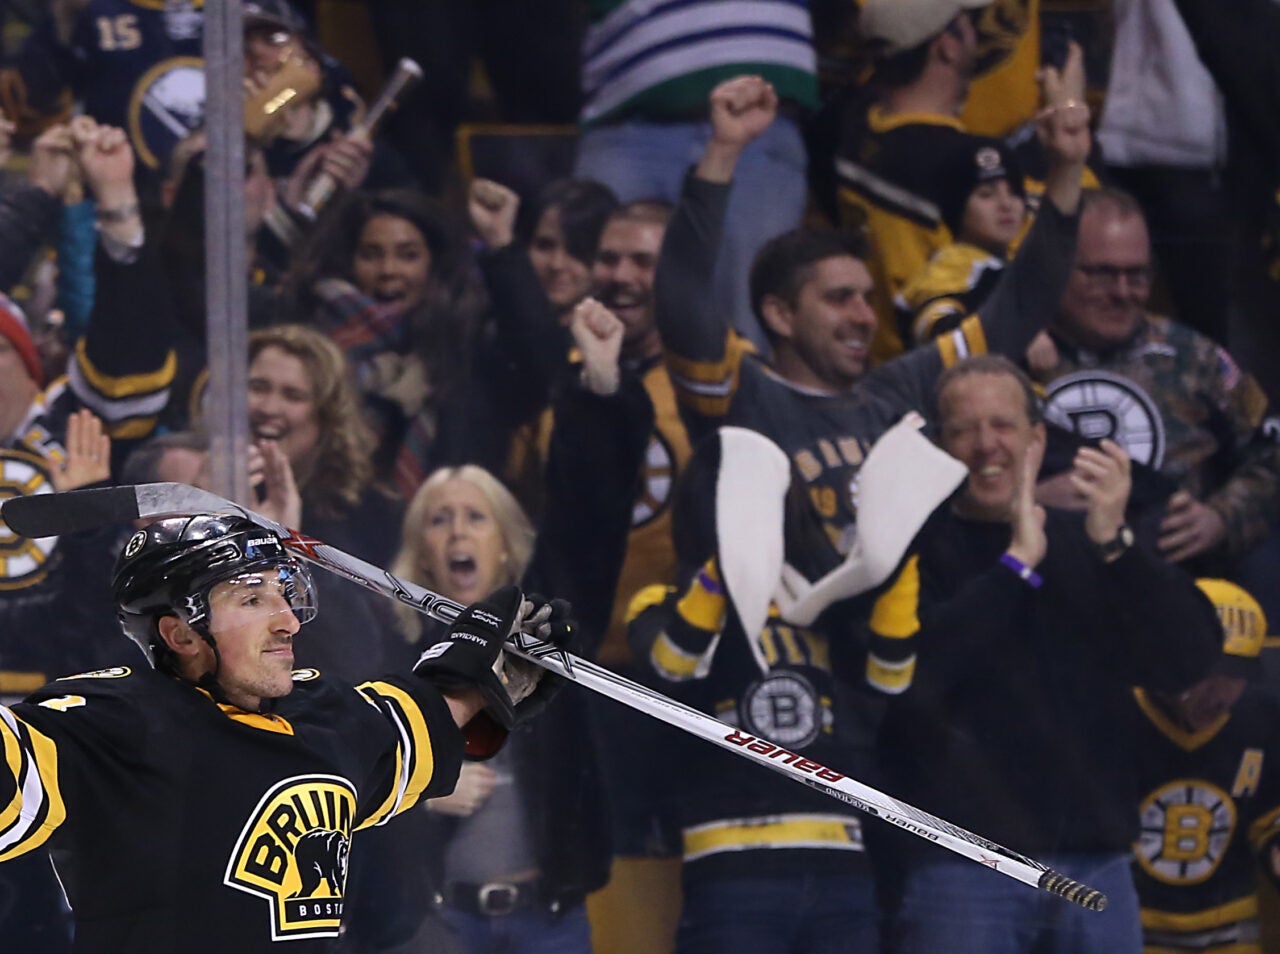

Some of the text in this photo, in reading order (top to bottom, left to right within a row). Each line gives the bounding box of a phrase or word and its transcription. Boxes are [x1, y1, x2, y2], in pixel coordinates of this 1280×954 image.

[97, 14, 143, 50] 15
[384, 571, 576, 679] VAOR
[724, 730, 846, 783] BAUER
[1232, 748, 1264, 798] A
[243, 790, 351, 886] BRUIN
[1162, 803, 1213, 861] B
[298, 903, 344, 917] BOST
